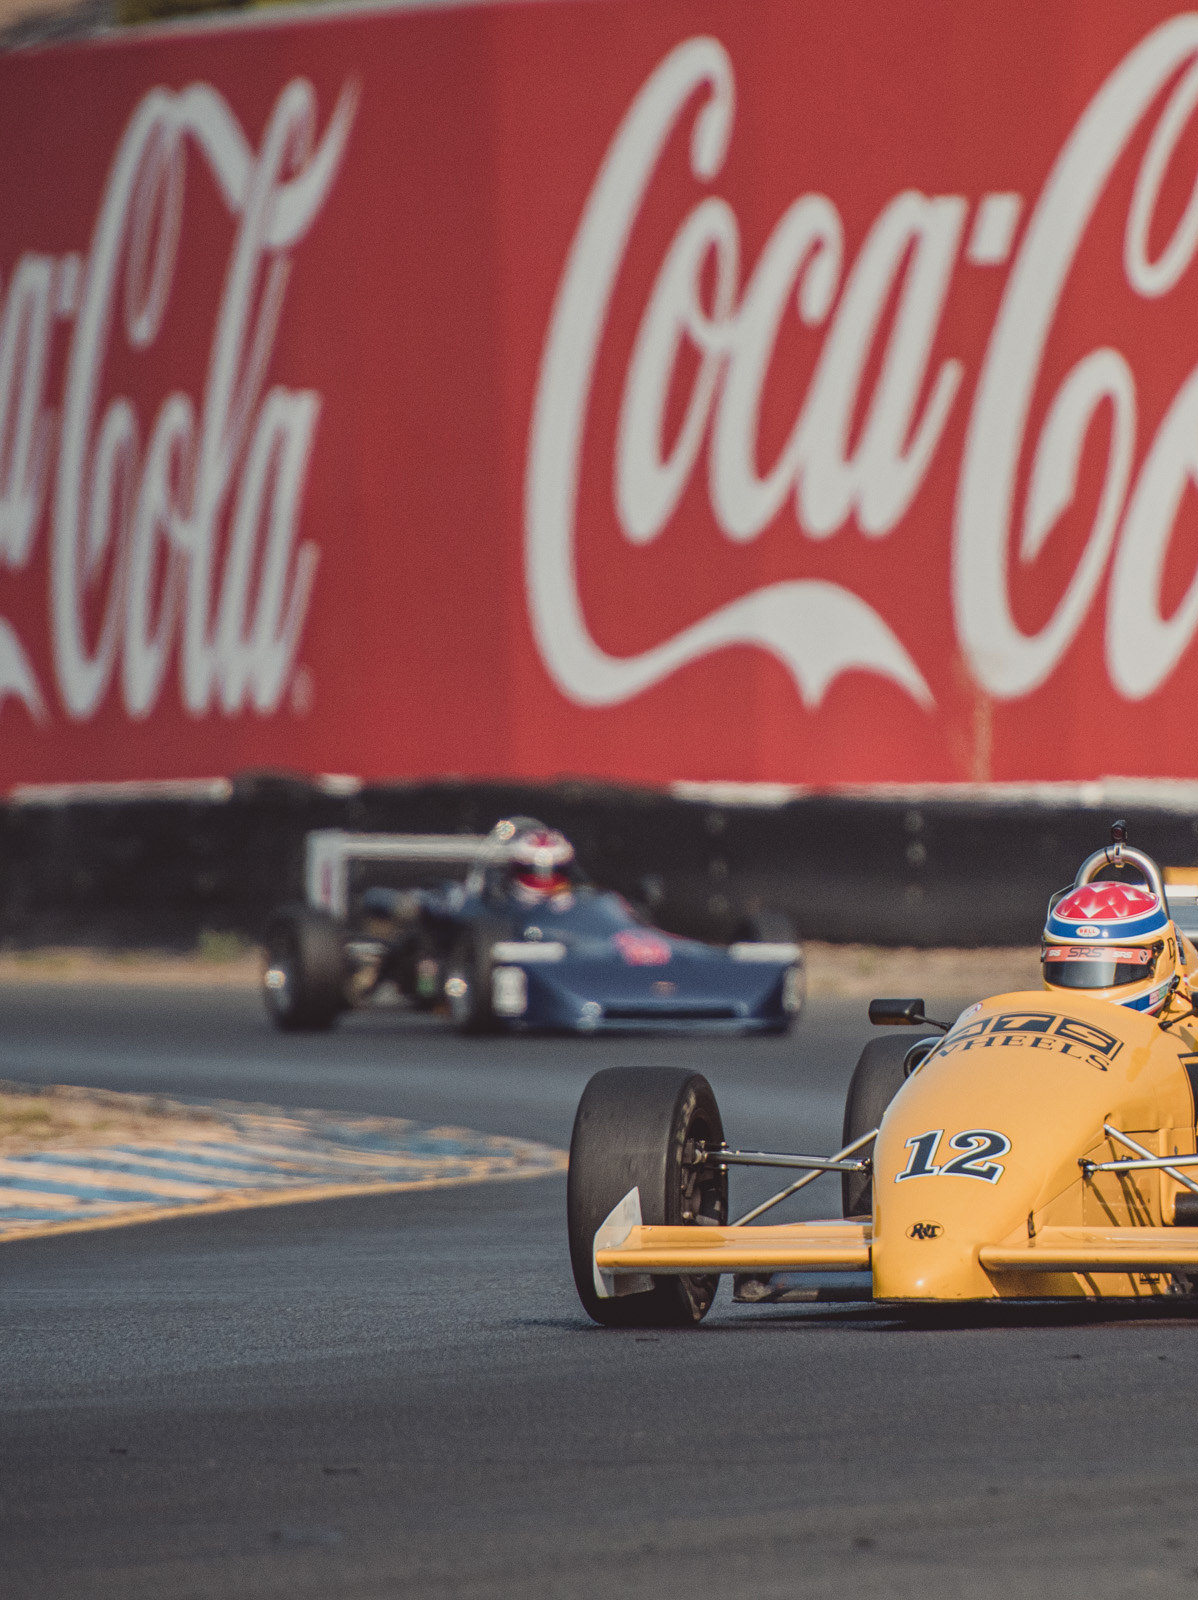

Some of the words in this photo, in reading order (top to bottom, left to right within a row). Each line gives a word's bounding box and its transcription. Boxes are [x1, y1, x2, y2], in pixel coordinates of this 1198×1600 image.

[1068, 947, 1105, 957] SRS
[946, 1014, 1117, 1053] ATS
[894, 1128, 1012, 1185] 12
